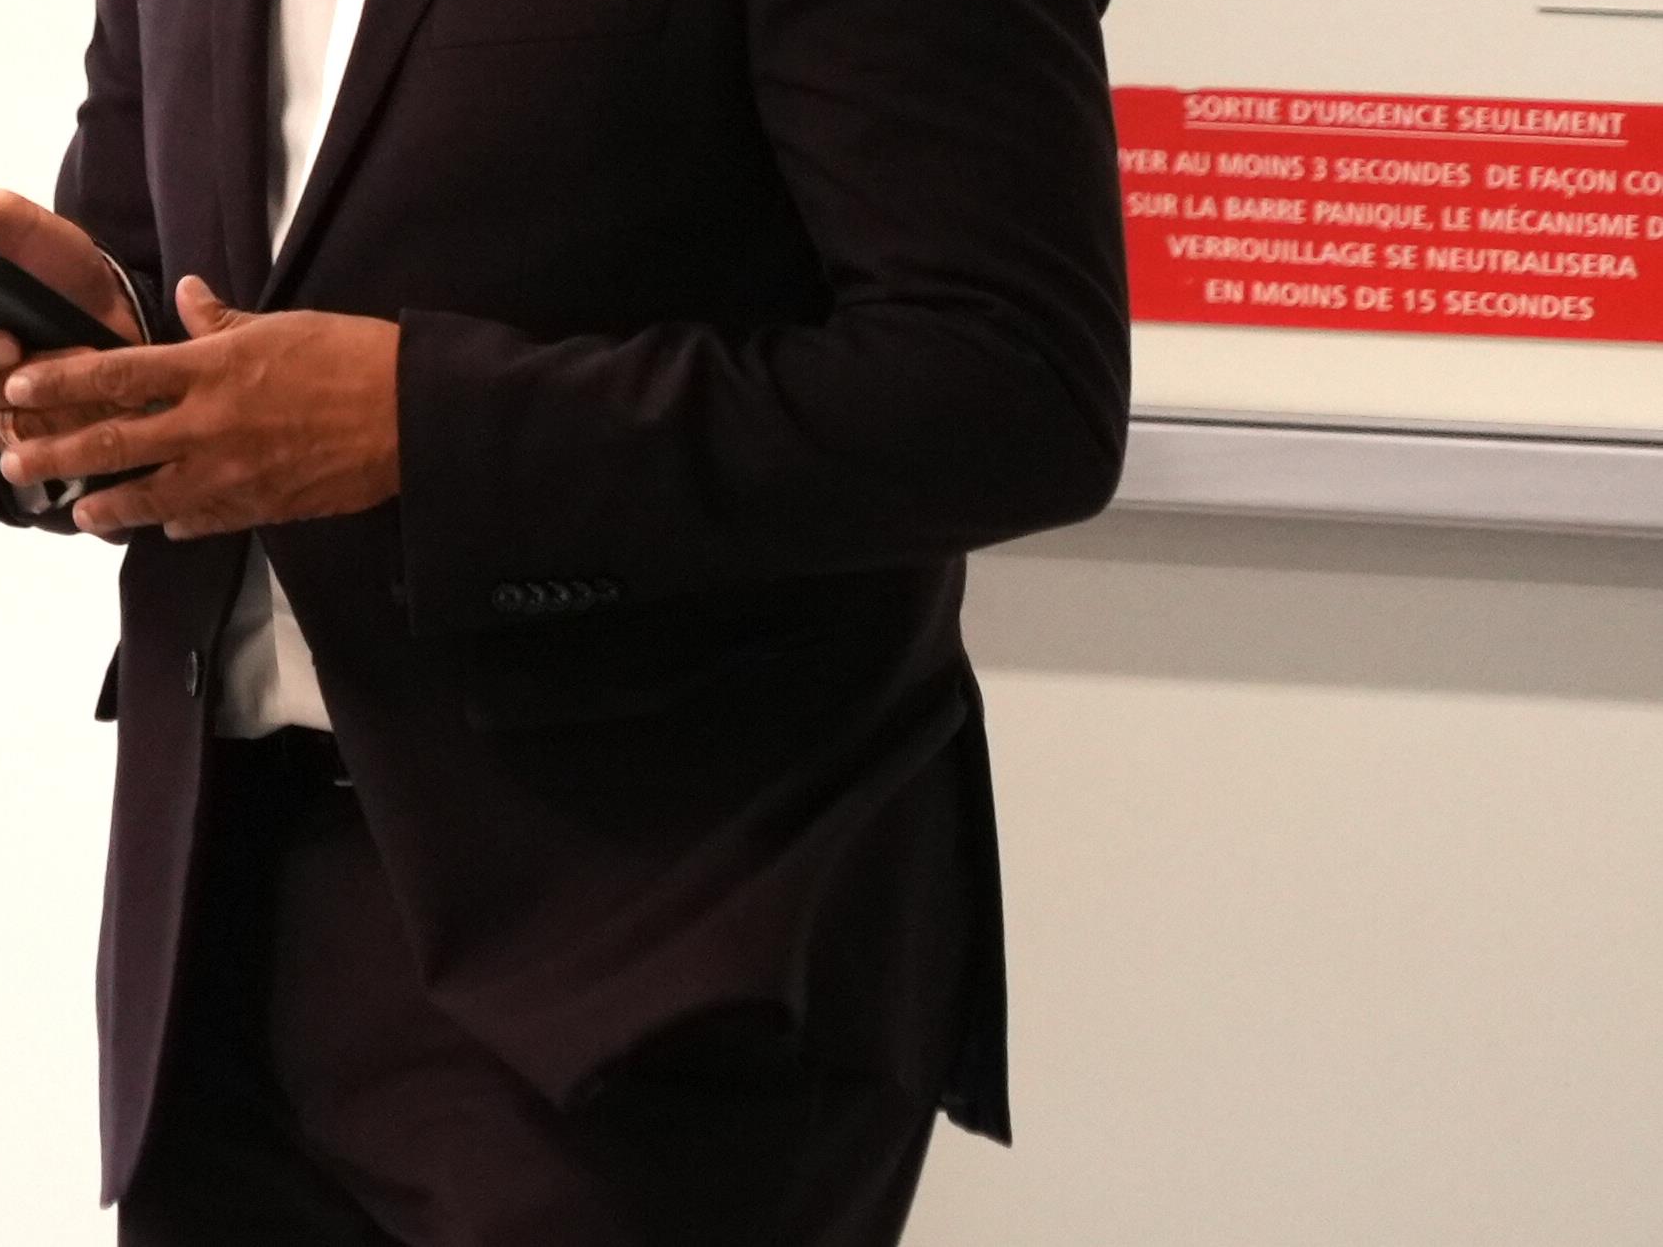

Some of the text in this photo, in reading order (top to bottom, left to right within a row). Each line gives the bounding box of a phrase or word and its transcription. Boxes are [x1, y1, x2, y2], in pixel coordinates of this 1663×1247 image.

[1186, 94, 1626, 136] SORTIE D'URGENCE SEULEMENT
[1174, 151, 1211, 176] AU
[1218, 153, 1305, 181] MOINS
[1311, 156, 1328, 181] 3
[1334, 158, 1472, 187] SECONDES
[1485, 164, 1522, 190] DE
[1528, 166, 1617, 199] FAÇON
[1127, 192, 1178, 218] SUR
[1185, 195, 1217, 220] LA
[1223, 197, 1306, 224] BARRE
[1441, 206, 1471, 231] LE
[1478, 204, 1639, 239] MÉCANISME
[1166, 235, 1638, 279] VERROUILLAGE SE NEUTRALISERA
[1204, 278, 1594, 321] EN MOINS DE 15 SECONDES
